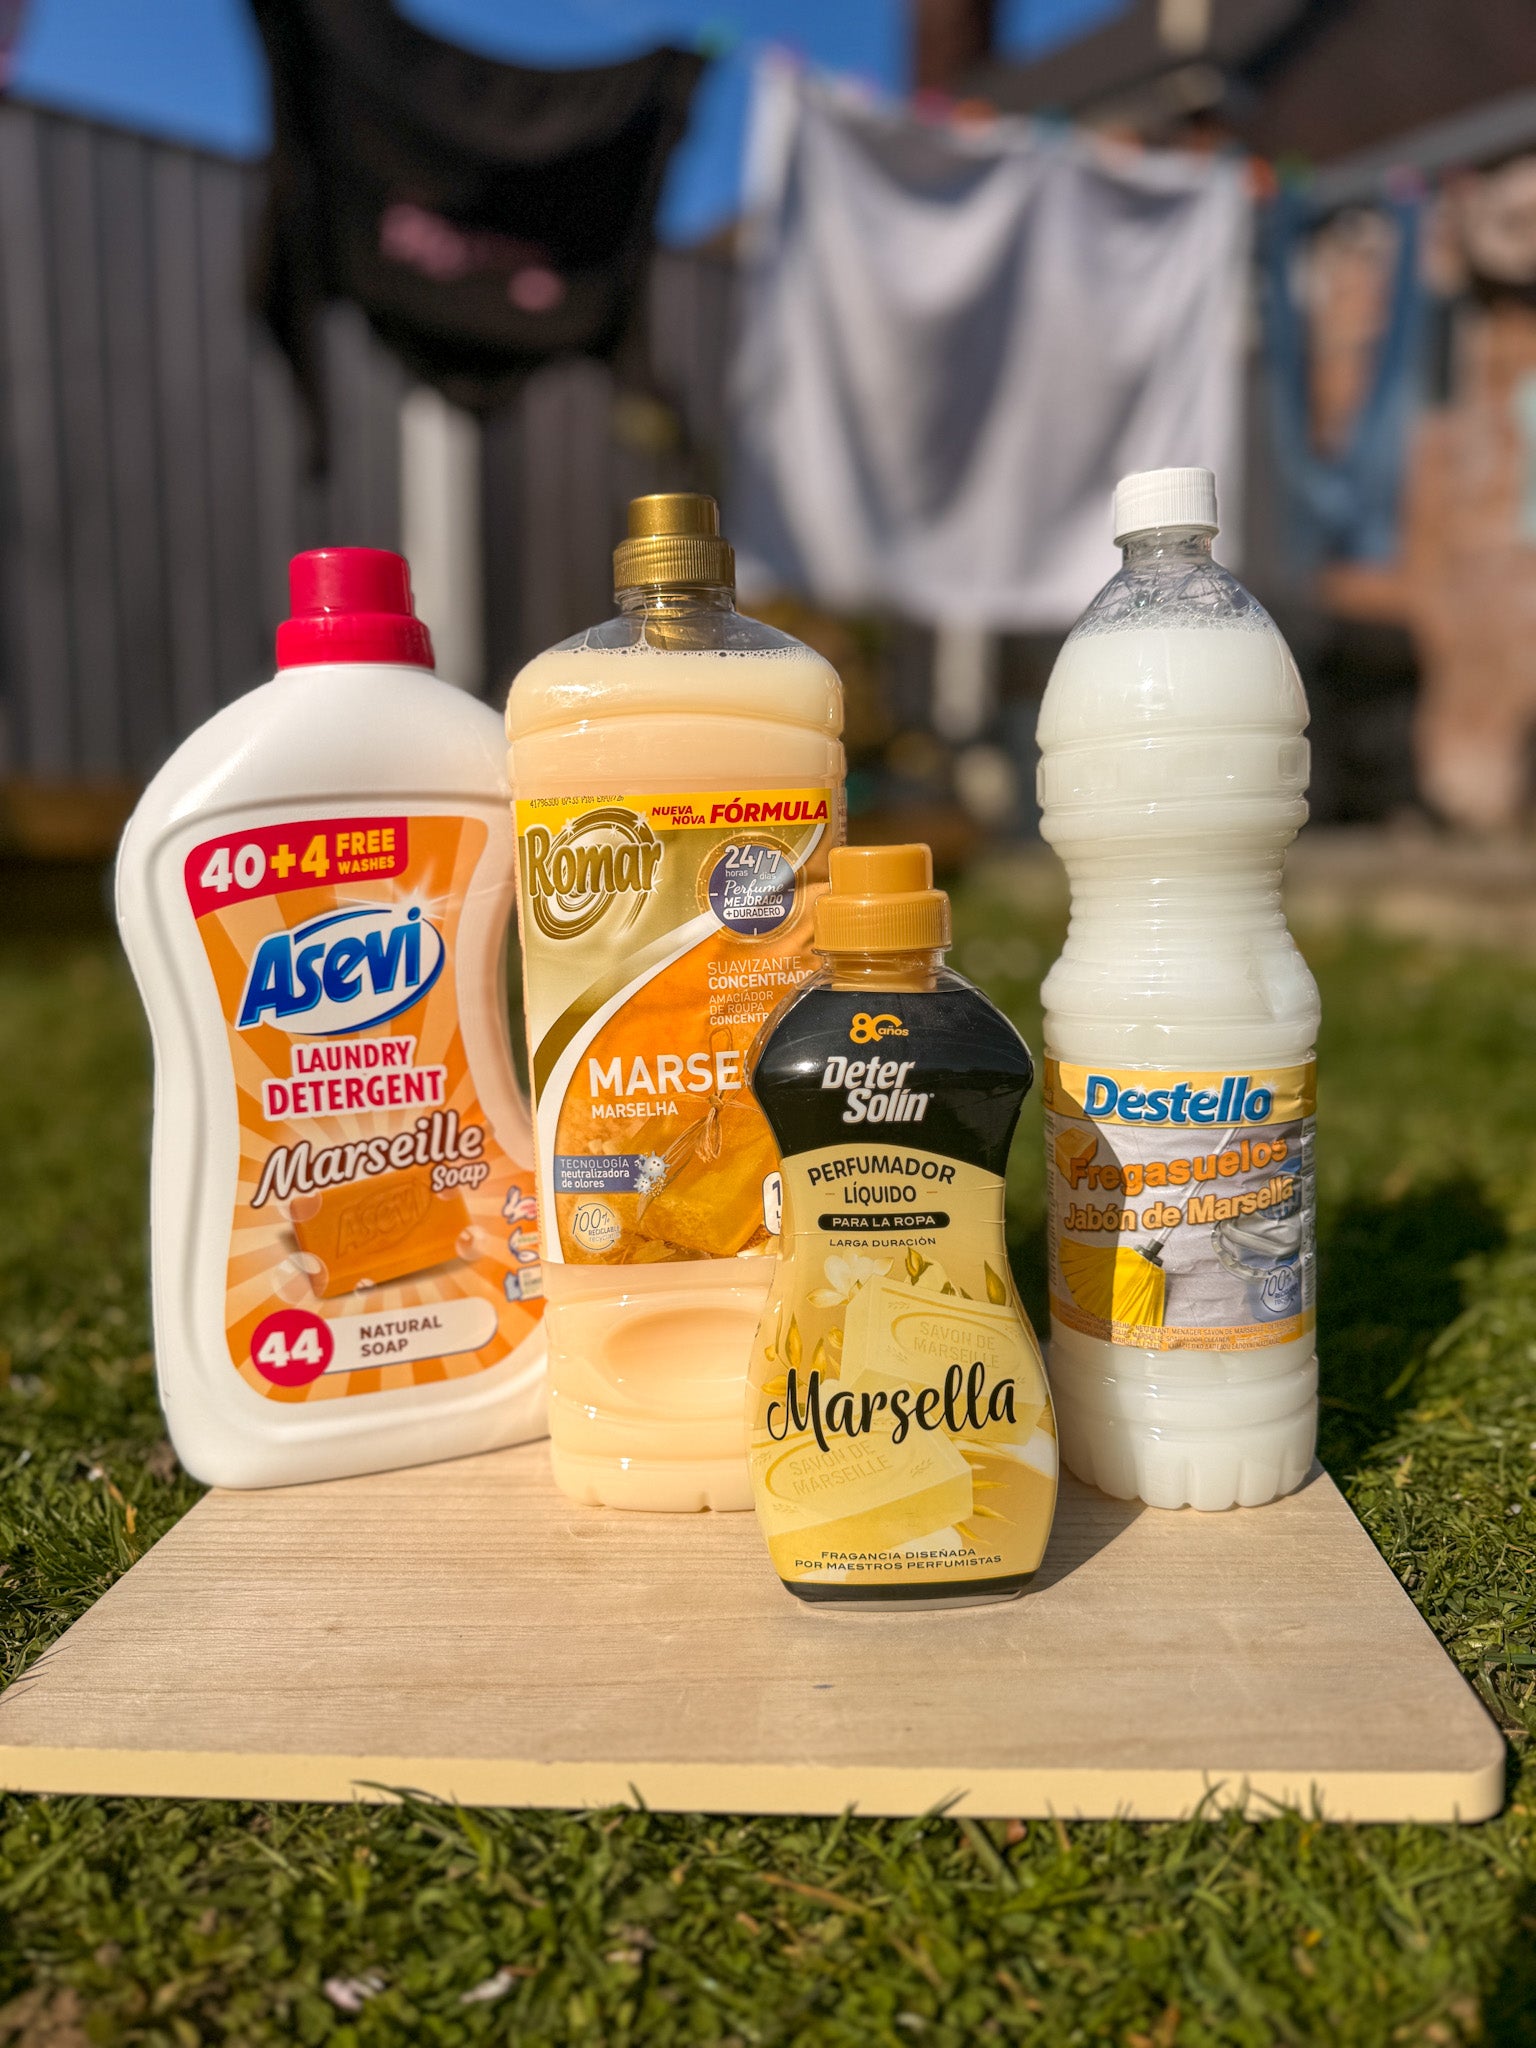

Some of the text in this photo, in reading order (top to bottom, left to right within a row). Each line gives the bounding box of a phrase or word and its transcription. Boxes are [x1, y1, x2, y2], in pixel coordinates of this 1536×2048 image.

[651, 805, 693, 817] NUEVA
[672, 814, 705, 825] NOVA
[710, 797, 829, 824] FÓRMULA
[336, 828, 395, 857] FREE
[338, 855, 396, 876] WASHES
[525, 826, 663, 898] Romar
[725, 869, 748, 877] horas
[724, 879, 784, 896] Perfume
[724, 895, 783, 908] MEJORADO
[238, 906, 423, 1028] Asevi
[708, 956, 801, 976] SUAVIZANTE
[710, 1002, 764, 1015] DE ROUPA
[710, 1012, 769, 1026] CONCENTR
[878, 1025, 909, 1036] años
[296, 1041, 411, 1073] LAUNDRY
[588, 1050, 748, 1097] MARSE
[821, 1056, 916, 1090] Deter
[268, 1070, 442, 1116] DETERGENT
[1084, 1075, 1273, 1124] Destello
[592, 1101, 679, 1119] MARSELHA
[251, 1110, 485, 1209] Marseille
[560, 1157, 630, 1168] TECNOLOGÍA
[807, 1155, 956, 1186] PERFUMADOR
[1070, 1138, 1288, 1196] Fregasuelos
[431, 1161, 490, 1193] Soap
[561, 1169, 630, 1179] neutralizadora
[561, 1178, 605, 1188] de olores
[844, 1181, 917, 1206] LÍQUIDO
[1064, 1175, 1294, 1232] Jabón de Marsella
[832, 1215, 936, 1228] PARA LA ROPA
[829, 1236, 936, 1247] LARGA DURACIÓN
[360, 1316, 442, 1340] NATURAL
[920, 1321, 995, 1351] SAVON DE
[257, 1328, 323, 1368] 44
[361, 1338, 408, 1357] SOAP
[914, 1337, 999, 1368] MARSEILLE
[767, 1361, 1017, 1453] Marsella
[789, 1439, 876, 1476] SAVON DE
[792, 1454, 895, 1495] MARSEILLE
[795, 1555, 1002, 1570] POR MAESTROS PERFUMISTAS
[821, 1548, 976, 1560] FRAGANCIA DISEÑADA
